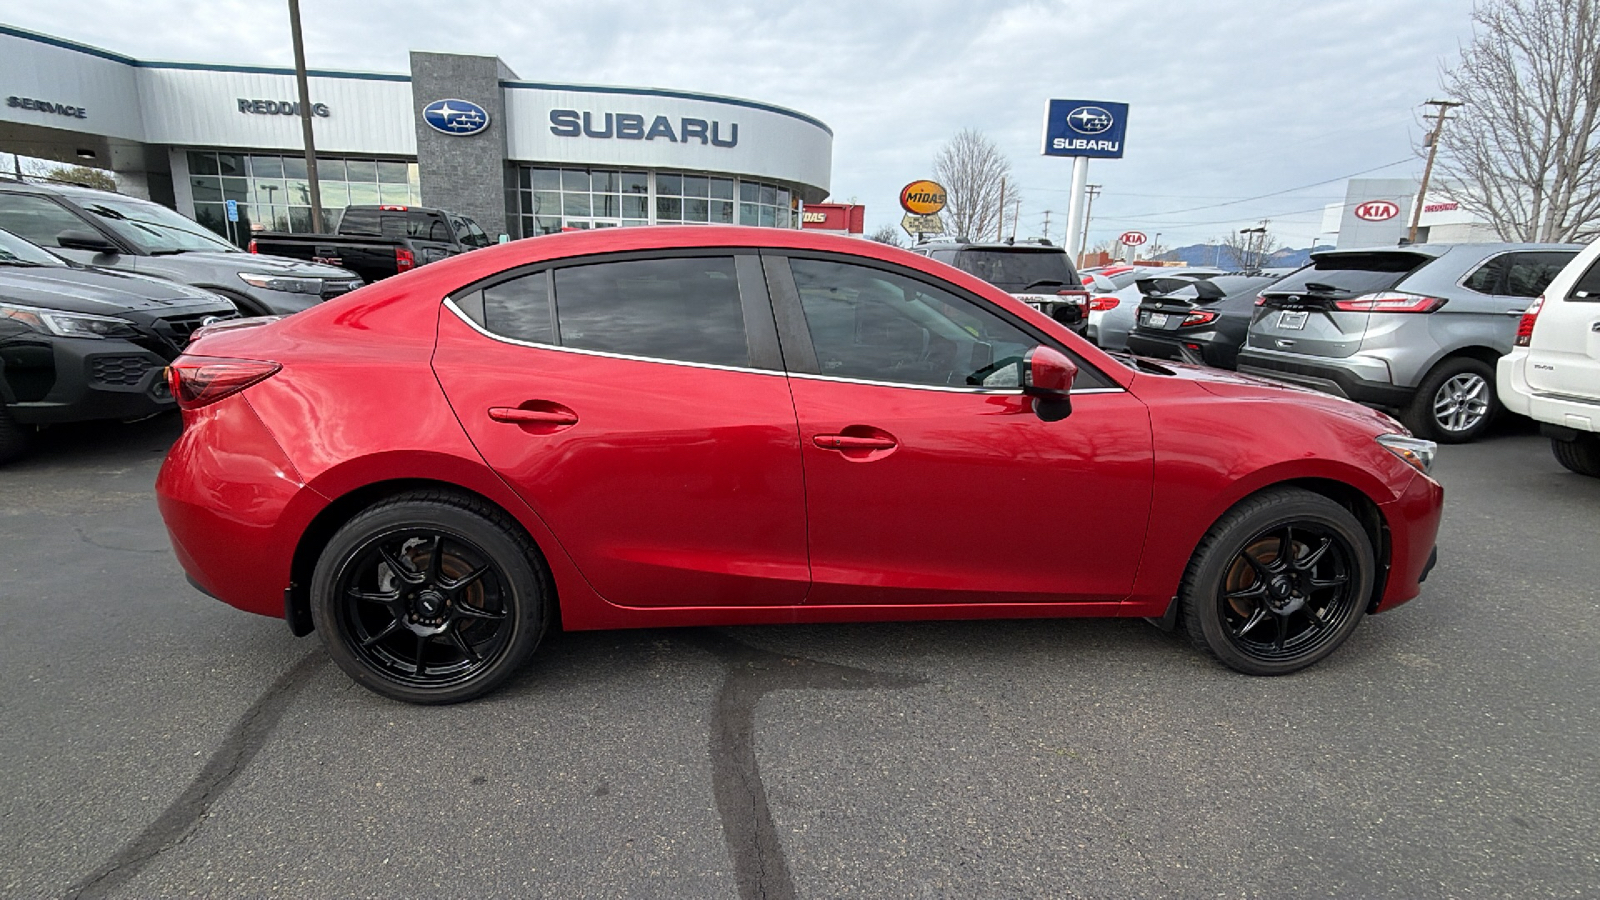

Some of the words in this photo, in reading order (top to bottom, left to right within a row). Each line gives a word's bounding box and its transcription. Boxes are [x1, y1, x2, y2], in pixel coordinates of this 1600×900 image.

[6, 96, 87, 119] SERVICE
[237, 98, 330, 117] REDDIG
[549, 108, 739, 148] SUBARU
[1052, 137, 1120, 153] SUBARU
[906, 188, 946, 204] MIDAS
[1361, 205, 1391, 218] KIA
[1124, 234, 1143, 244] KIA
